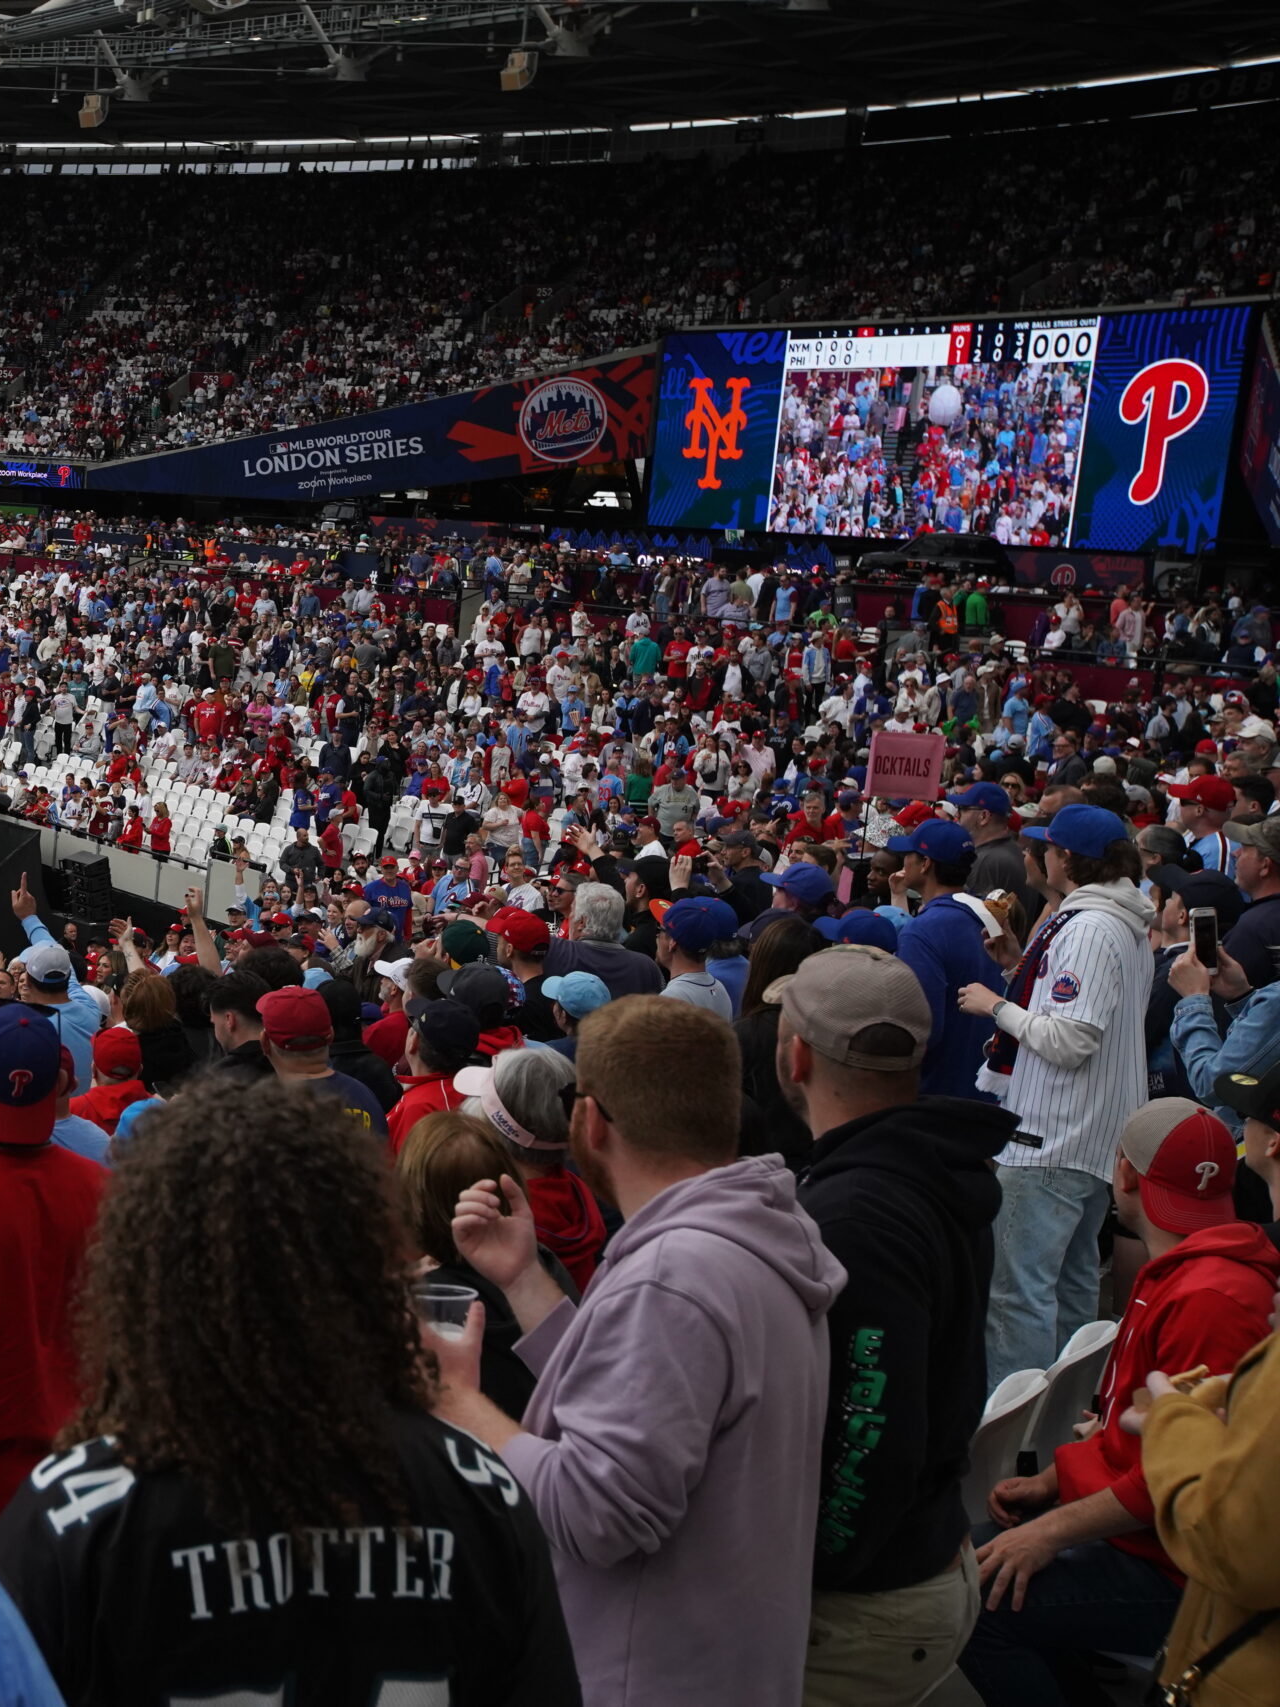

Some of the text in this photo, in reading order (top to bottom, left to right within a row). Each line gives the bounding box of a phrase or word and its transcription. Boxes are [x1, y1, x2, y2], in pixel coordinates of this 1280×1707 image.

[536, 287, 553, 297] 252
[952, 324, 972, 333] RUNS
[1031, 319, 1051, 328] BALLS
[1052, 319, 1078, 328] STRIKES
[1079, 318, 1097, 327] OUTS
[789, 332, 1025, 353] NYM 0 0 0 0 1 0 3
[1033, 332, 1091, 358] 0 0 0
[790, 347, 1023, 366] PHI 1 0 0 1 2 0 4
[202, 375, 219, 385] 253
[536, 408, 591, 440] Mets
[289, 428, 392, 453] MLB WORLD TOUR
[243, 436, 425, 477] LONDON SERIES
[18, 470, 48, 479] Workplace
[298, 473, 373, 489] zoom Workplace
[874, 755, 931, 778] OCKTAILS
[1194, 1161, 1220, 1191] P
[169, 1525, 456, 1621] TROTTER
